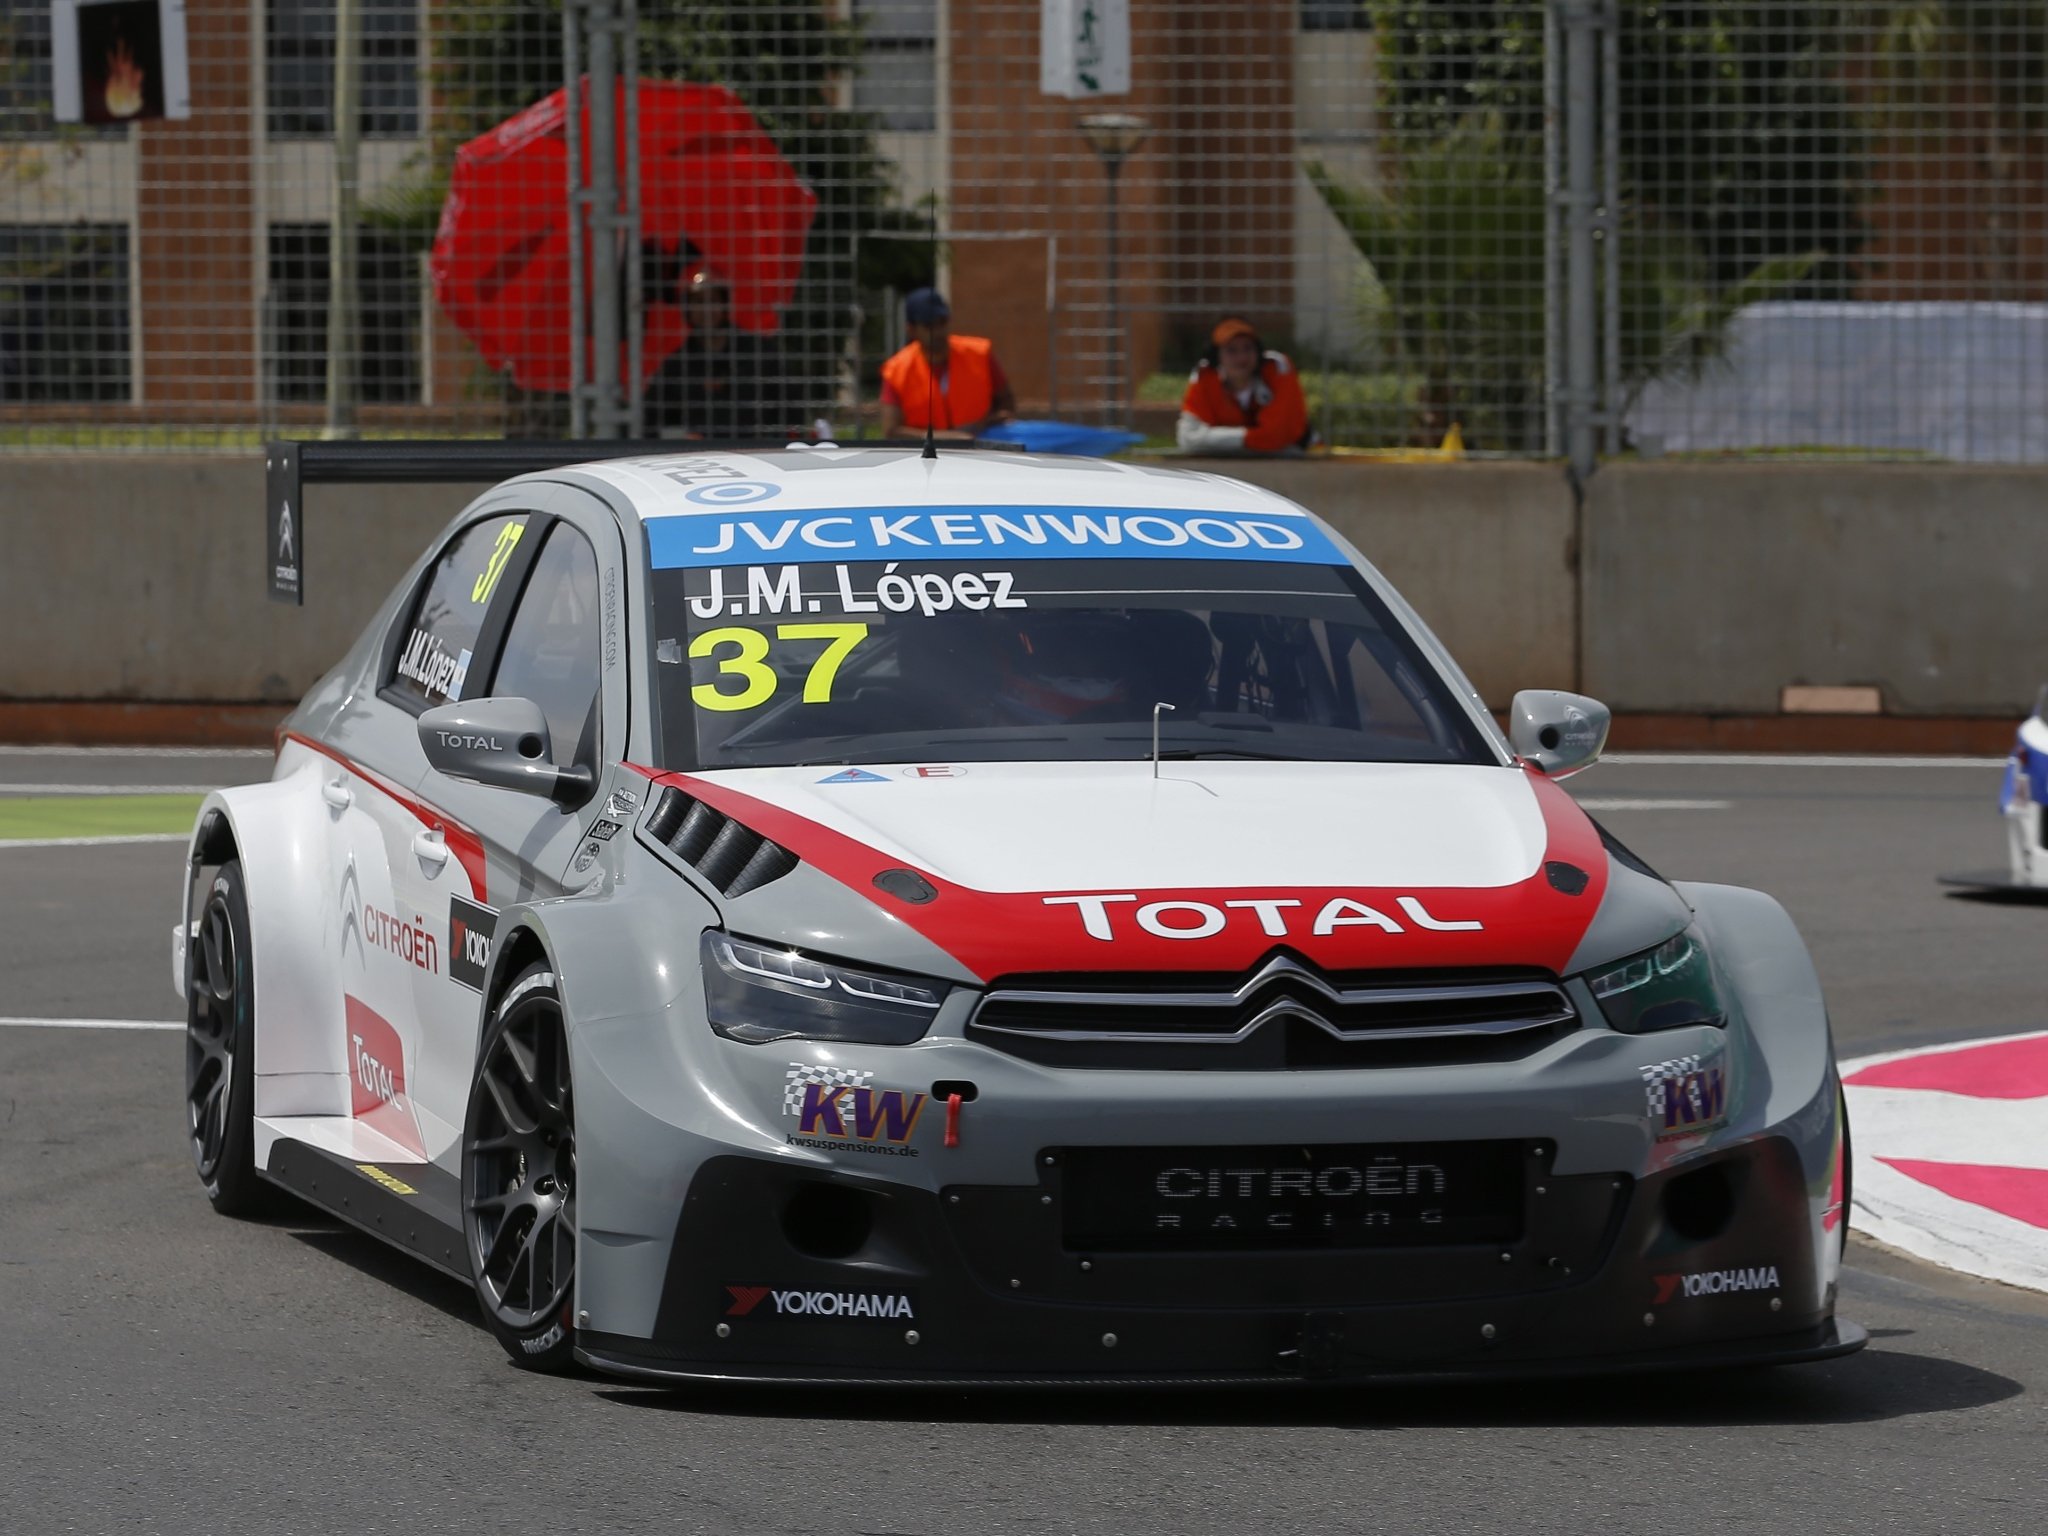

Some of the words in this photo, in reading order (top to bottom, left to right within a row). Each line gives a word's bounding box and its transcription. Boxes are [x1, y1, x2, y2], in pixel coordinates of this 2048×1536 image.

[692, 517, 857, 554] JVC
[869, 514, 1304, 550] KENWOOD
[473, 521, 525, 604] 37
[690, 564, 822, 619] J.M.
[835, 562, 1028, 617] López
[688, 623, 869, 712] 37
[436, 731, 503, 751] TOTAL
[364, 904, 438, 975] CITROËN
[1041, 893, 1485, 942] TOTAL
[352, 1033, 404, 1112] TOTAL
[799, 1082, 929, 1144] KW
[1664, 1069, 1725, 1130] KW
[785, 1133, 919, 1158] kwsuspensions.de
[1155, 1156, 1446, 1198] CITROËN
[1156, 1209, 1443, 1227] RACING
[771, 1290, 914, 1319] YOKOHAMA
[1681, 1265, 1780, 1298] YOKOHAMA
